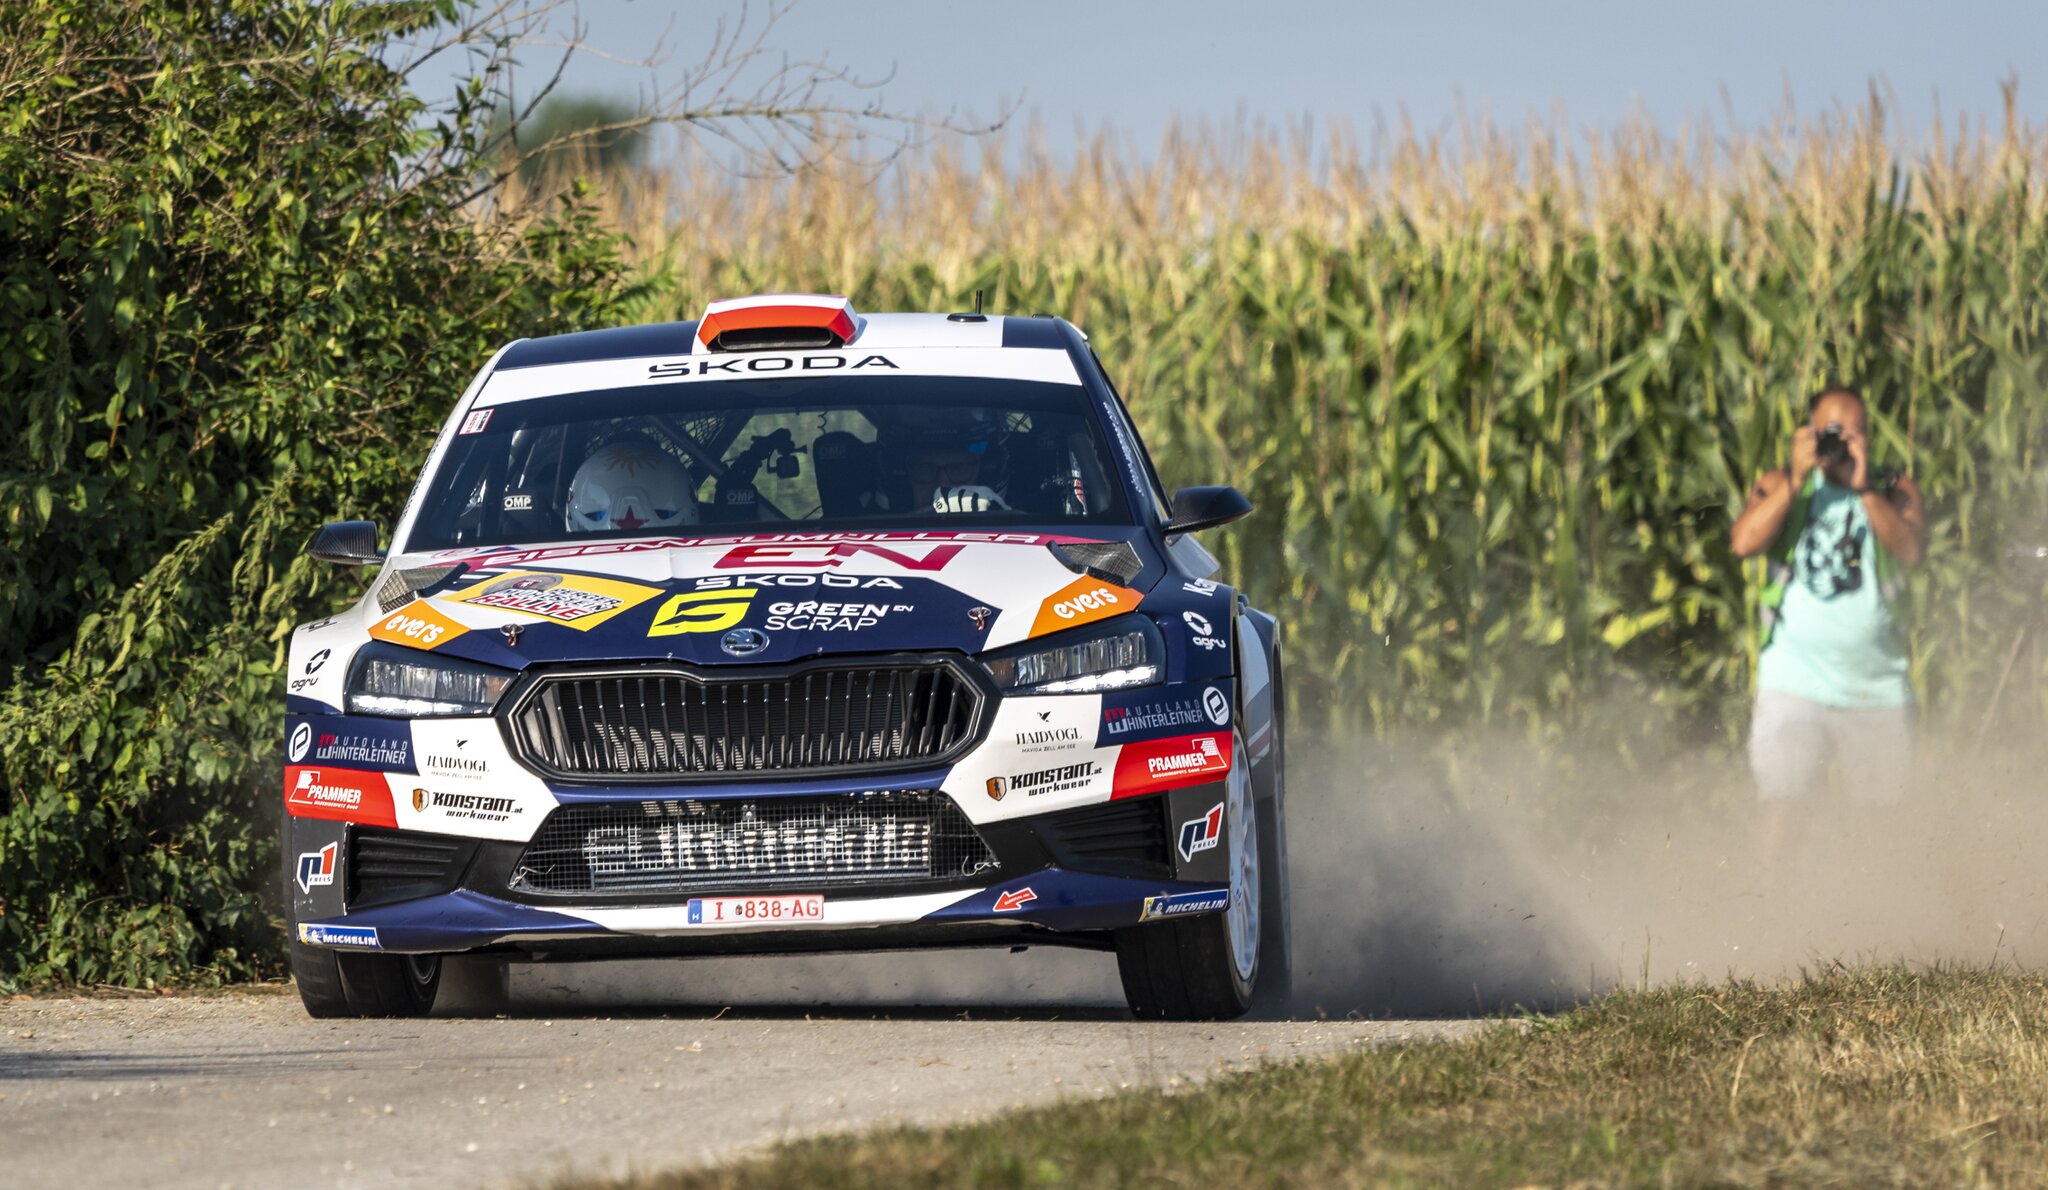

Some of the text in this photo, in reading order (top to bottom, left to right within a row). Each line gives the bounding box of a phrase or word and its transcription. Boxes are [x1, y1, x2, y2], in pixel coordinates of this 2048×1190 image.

[504, 496, 532, 510] OMP
[713, 543, 967, 571] EN
[474, 595, 589, 618] RALLYE
[768, 600, 889, 618] GREEN
[1054, 586, 1118, 619] evers
[385, 614, 444, 643] evers
[764, 614, 878, 631] SCRAP
[1192, 637, 1226, 650] agru
[291, 677, 319, 692] agru
[1125, 699, 1200, 717] AUTOLAND
[1127, 710, 1205, 731] HINTERLEITNER
[334, 735, 408, 750] AUTOLAND
[1016, 727, 1082, 745] HAIDVOGL
[331, 745, 406, 765] HINTERLEITNER
[427, 755, 489, 772] HAIDVOGL
[1148, 752, 1206, 773] PRAMMER
[307, 785, 362, 804] PRAMMER
[1028, 779, 1091, 797] workwear
[446, 810, 509, 822] workwear
[745, 899, 819, 918] 838-AG
[1164, 899, 1226, 914] MICHELIN
[322, 934, 376, 946] MICHELIN
